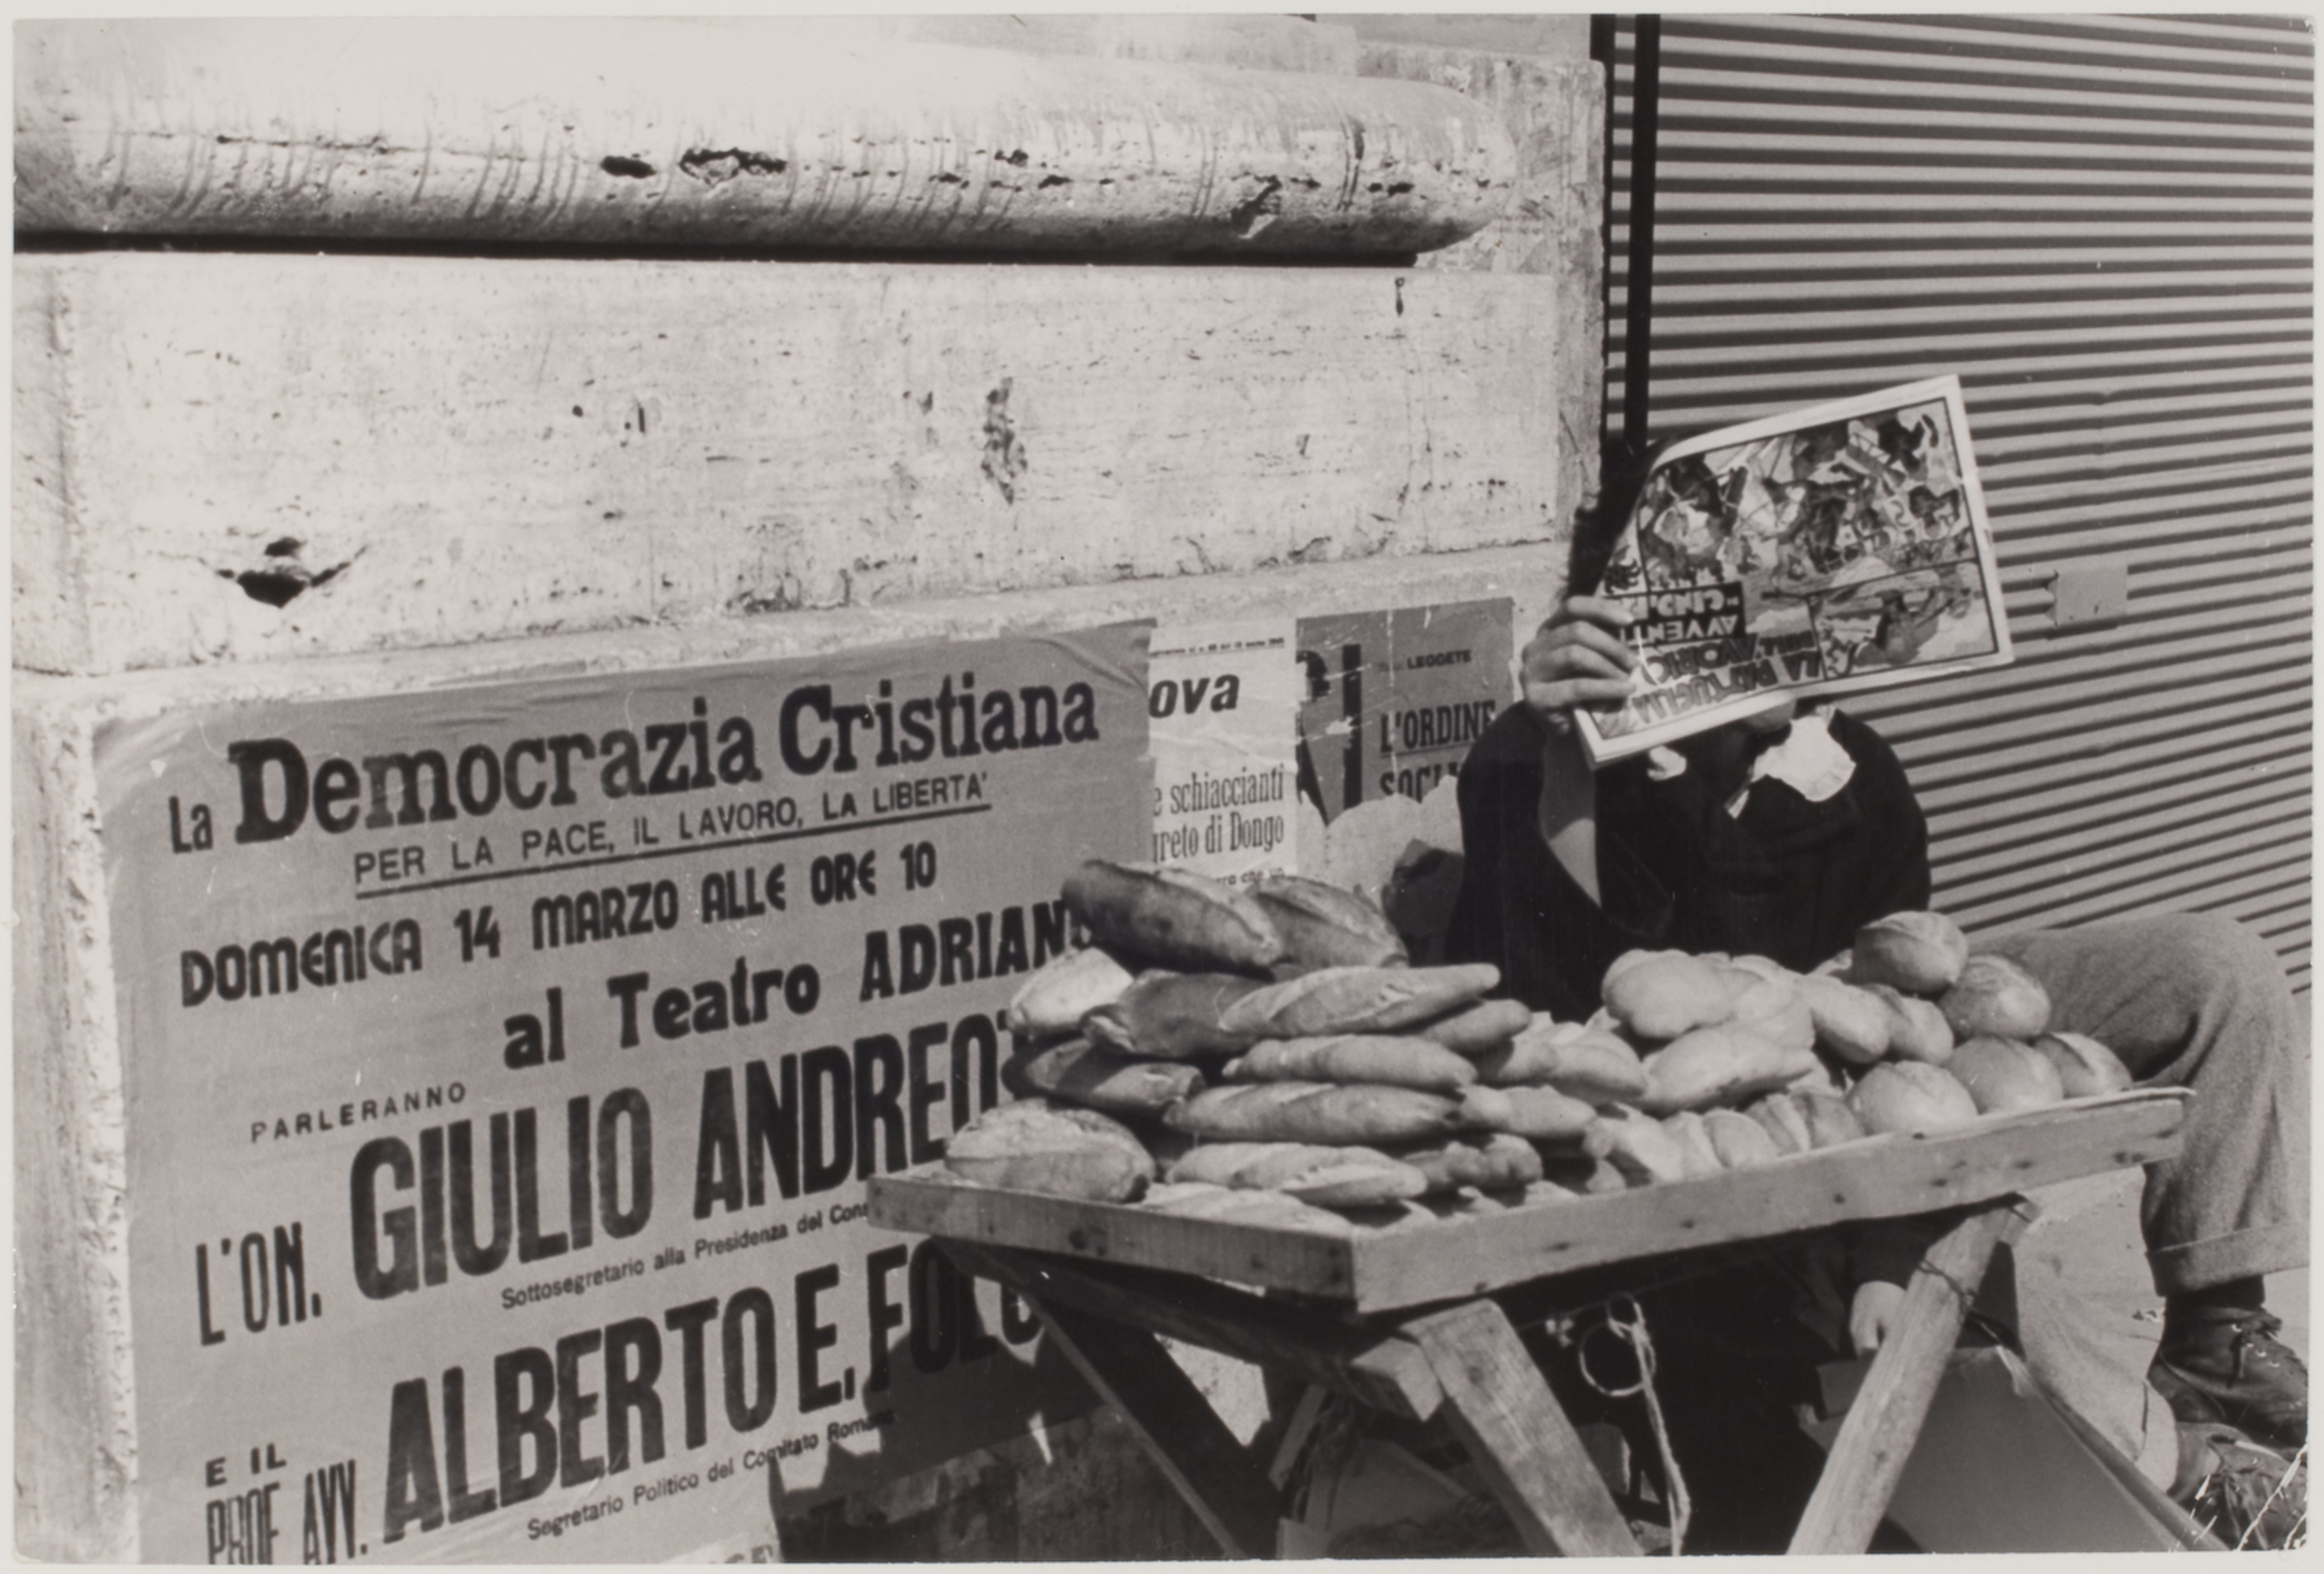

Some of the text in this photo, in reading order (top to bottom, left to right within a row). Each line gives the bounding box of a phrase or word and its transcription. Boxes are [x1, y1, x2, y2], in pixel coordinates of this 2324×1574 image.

[1406, 649, 1472, 669] LEGGETE
[1780, 651, 1823, 682] LA
[168, 671, 1100, 855] La Democrazia Cristiana
[1170, 762, 1284, 815] schiaccianti
[354, 845, 426, 885] PER
[452, 836, 495, 871] LA
[522, 820, 615, 862] PACE,
[634, 815, 660, 846] IL
[680, 796, 804, 840] LAVORO,
[823, 790, 858, 822] LA
[1205, 814, 1222, 854] di
[1229, 811, 1284, 853] Dongo
[180, 840, 937, 1009] DOMENICA 14 MARZO ALLE ORE 10
[504, 986, 566, 1070] al
[606, 955, 821, 1050] Teatro
[251, 1081, 467, 1144] PARLERANNO
[195, 1008, 1019, 1347] L'ON. GIULIO ANDREO
[501, 1259, 645, 1310] Sottosegretario
[654, 1248, 686, 1272] alla
[695, 1223, 788, 1259] Presidenza
[797, 1211, 823, 1235] del
[382, 1286, 778, 1545] ALBERTO
[205, 1442, 287, 1488] E IL
[527, 1498, 625, 1541] Segretario
[633, 1469, 699, 1507] Politico
[707, 1456, 734, 1484] del
[744, 1432, 819, 1471] Comitato
